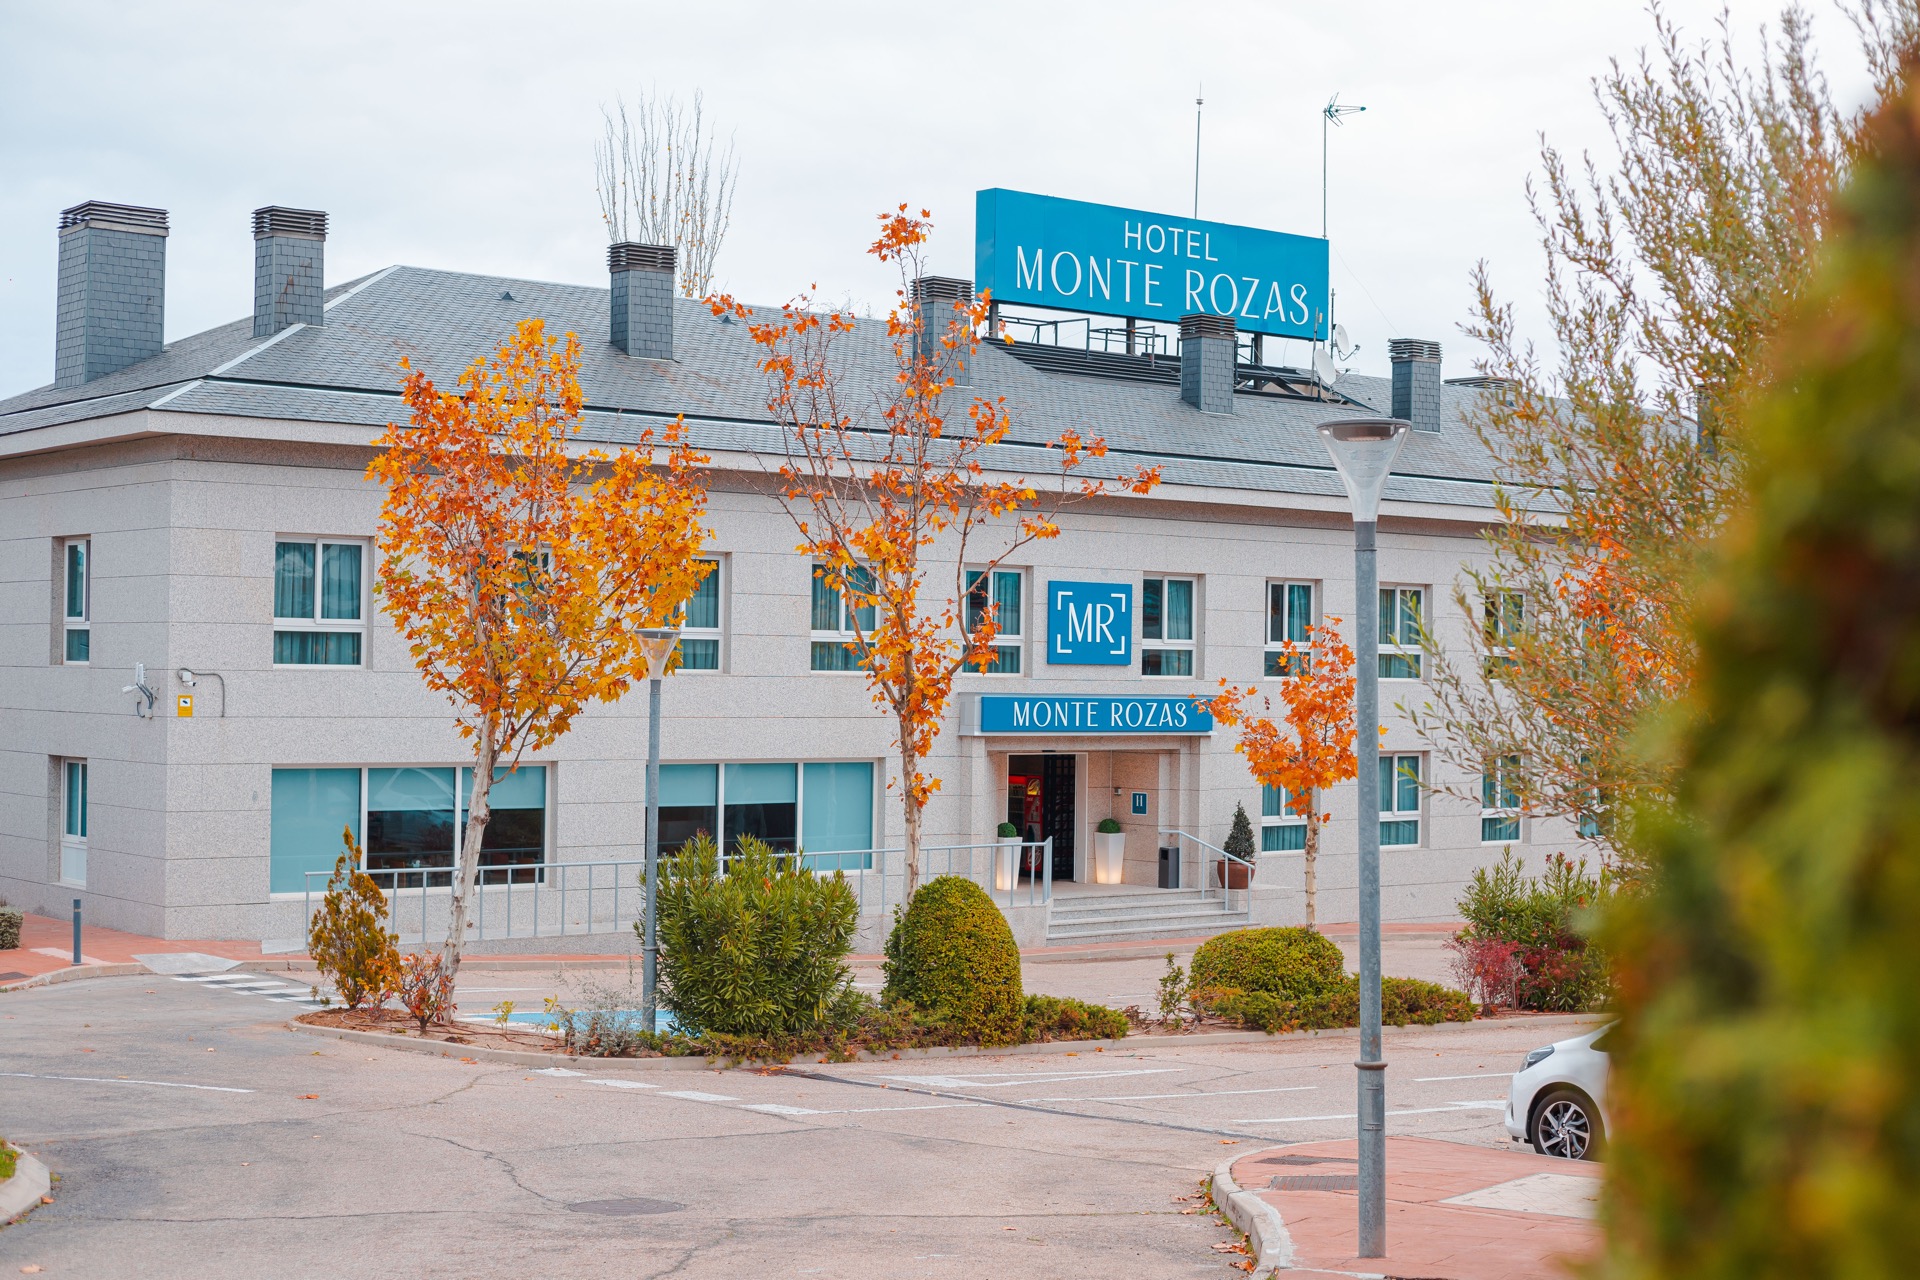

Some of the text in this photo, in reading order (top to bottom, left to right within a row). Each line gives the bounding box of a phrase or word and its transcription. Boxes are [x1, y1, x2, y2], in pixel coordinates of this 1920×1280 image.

[1124, 220, 1219, 262] HOTEL
[1016, 245, 1309, 325] MONTE ROZAS
[1068, 602, 1115, 644] MR
[1013, 701, 1187, 728] MONTE ROZAS
